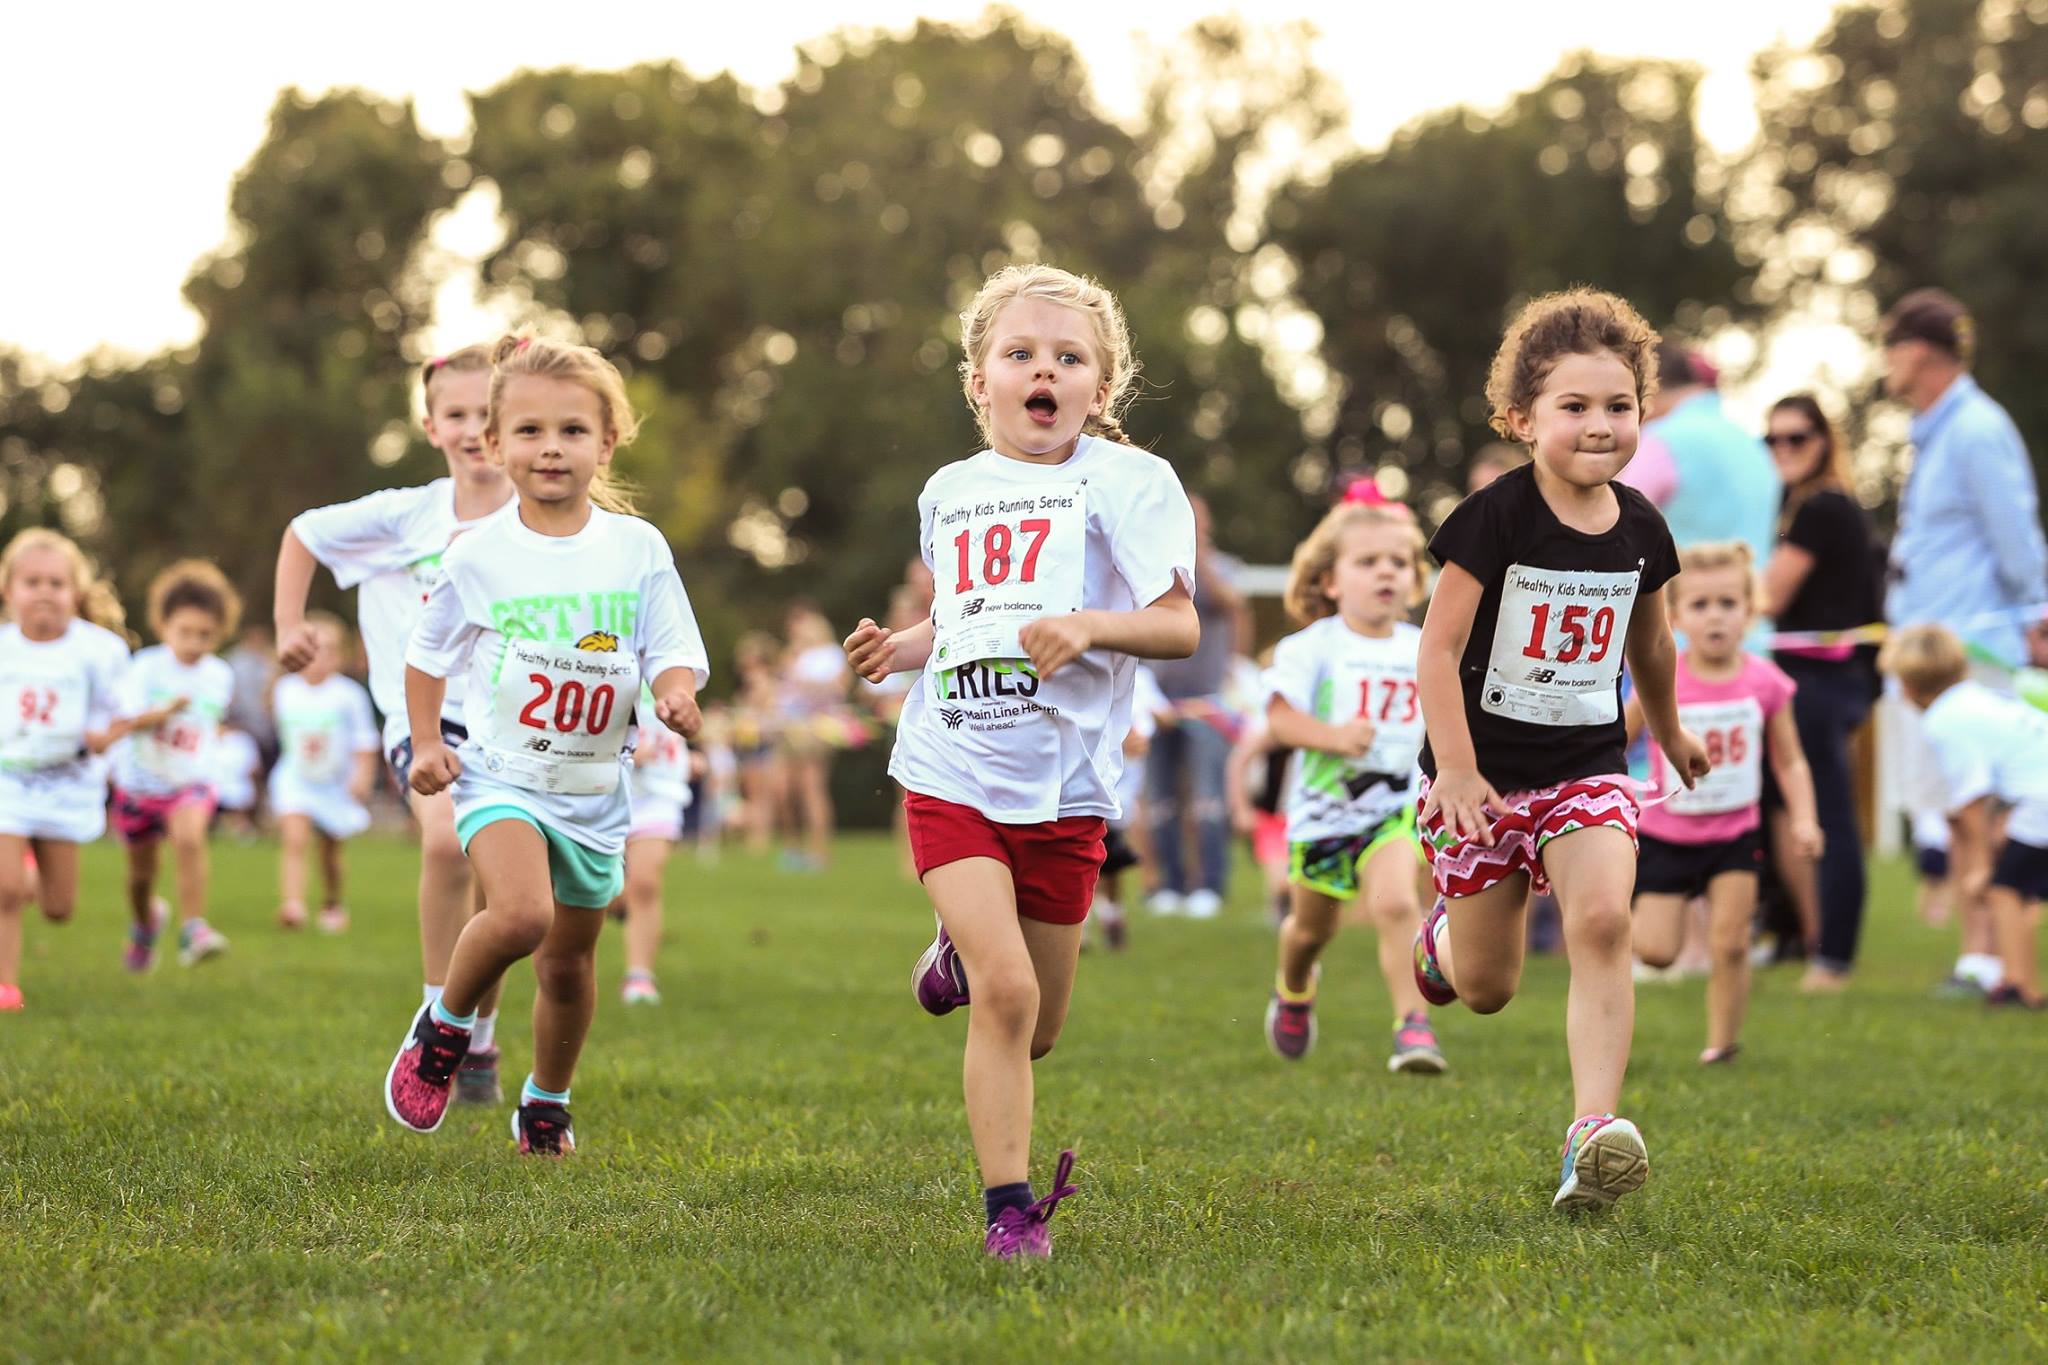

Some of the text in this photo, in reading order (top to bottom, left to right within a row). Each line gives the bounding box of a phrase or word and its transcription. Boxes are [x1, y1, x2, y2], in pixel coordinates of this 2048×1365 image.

[941, 495, 1073, 527] Healthy Kids Running Series
[954, 518, 1050, 595] 187
[1516, 576, 1632, 600] Healthy Kids Running Series
[985, 603, 1002, 613] new
[1003, 602, 1043, 611] balance
[1521, 603, 1615, 663] 159
[516, 648, 550, 670] Healthy
[554, 657, 572, 671] Kids
[576, 660, 607, 678] Running
[519, 672, 615, 735] 200
[964, 709, 991, 720] Main
[993, 706, 1019, 719] Line
[1357, 677, 1419, 723] 173
[968, 722, 985, 732] Well
